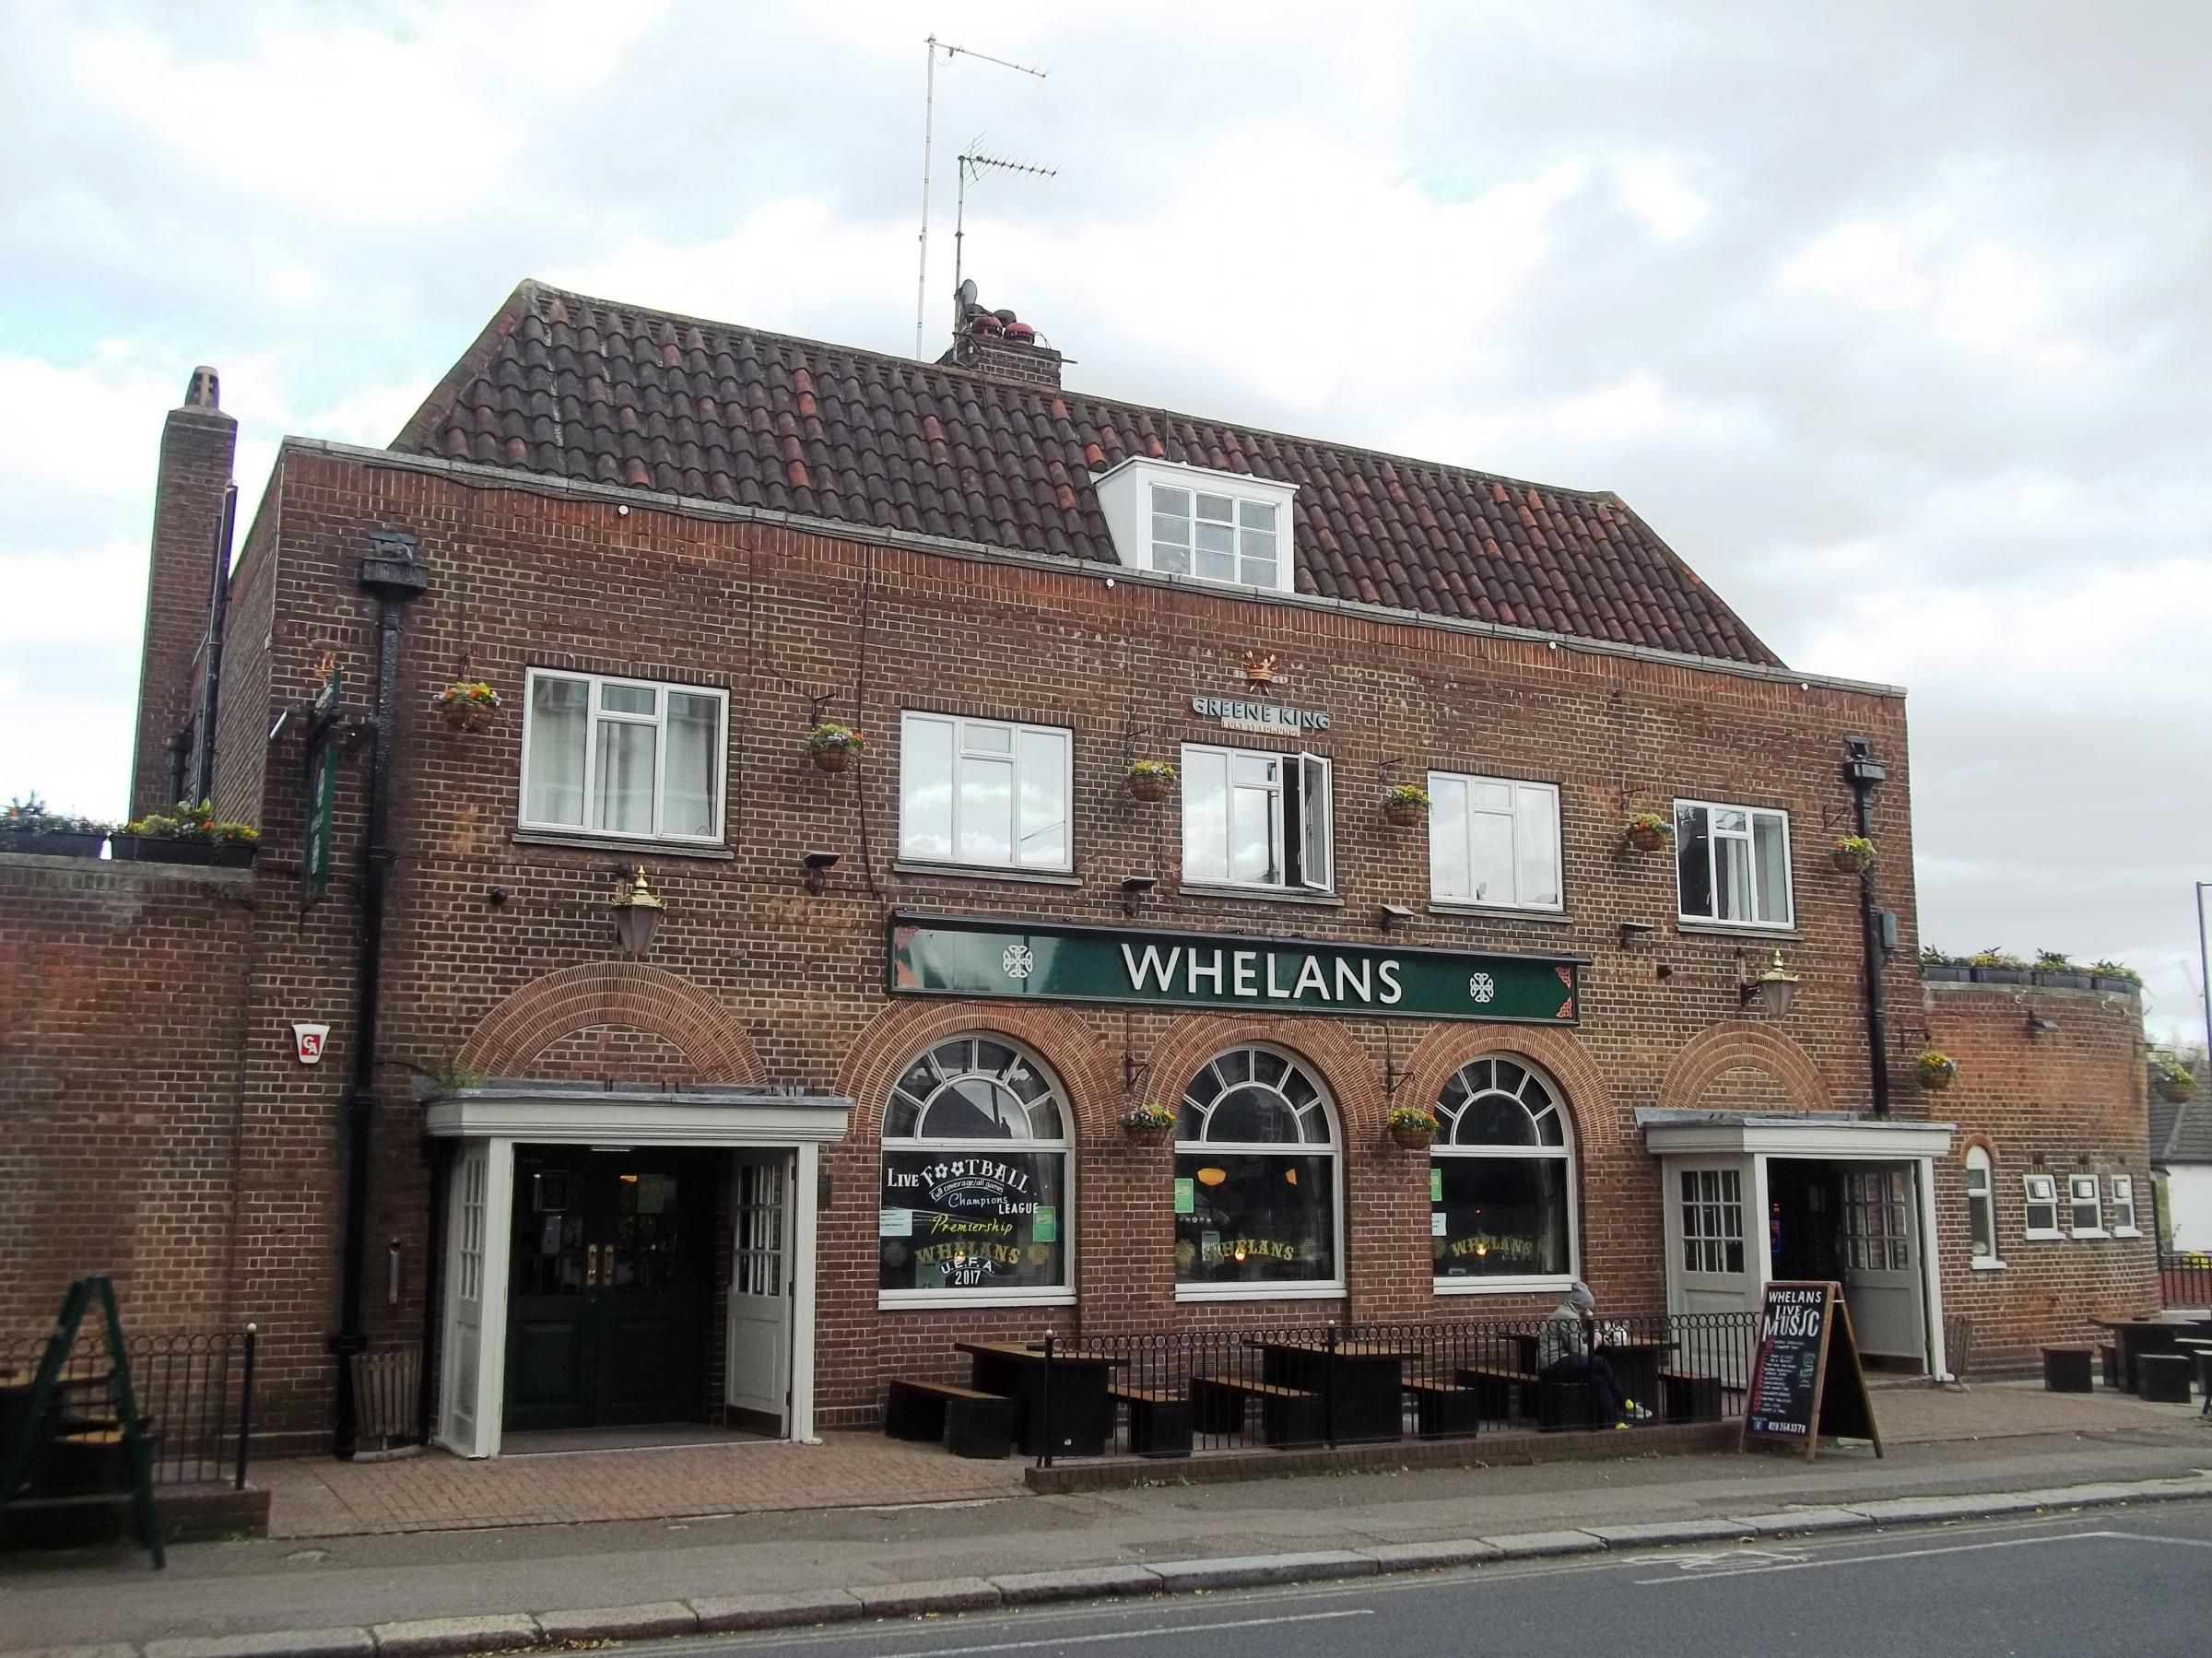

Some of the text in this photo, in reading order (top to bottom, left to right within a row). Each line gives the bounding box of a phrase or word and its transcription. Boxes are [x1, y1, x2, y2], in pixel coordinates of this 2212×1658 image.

[1192, 697, 1331, 730] GREENE KING
[1122, 943, 1402, 1004] WHELANS
[948, 1193, 1008, 1208] Champions
[998, 1202, 1040, 1215] LEAGUE
[931, 1213, 1013, 1237] Premiership
[955, 1270, 981, 1285] 2017
[1769, 1291, 1822, 1303] WHELANS
[1775, 1304, 1803, 1321] LIVE
[1762, 1308, 1820, 1342] MUSIC
